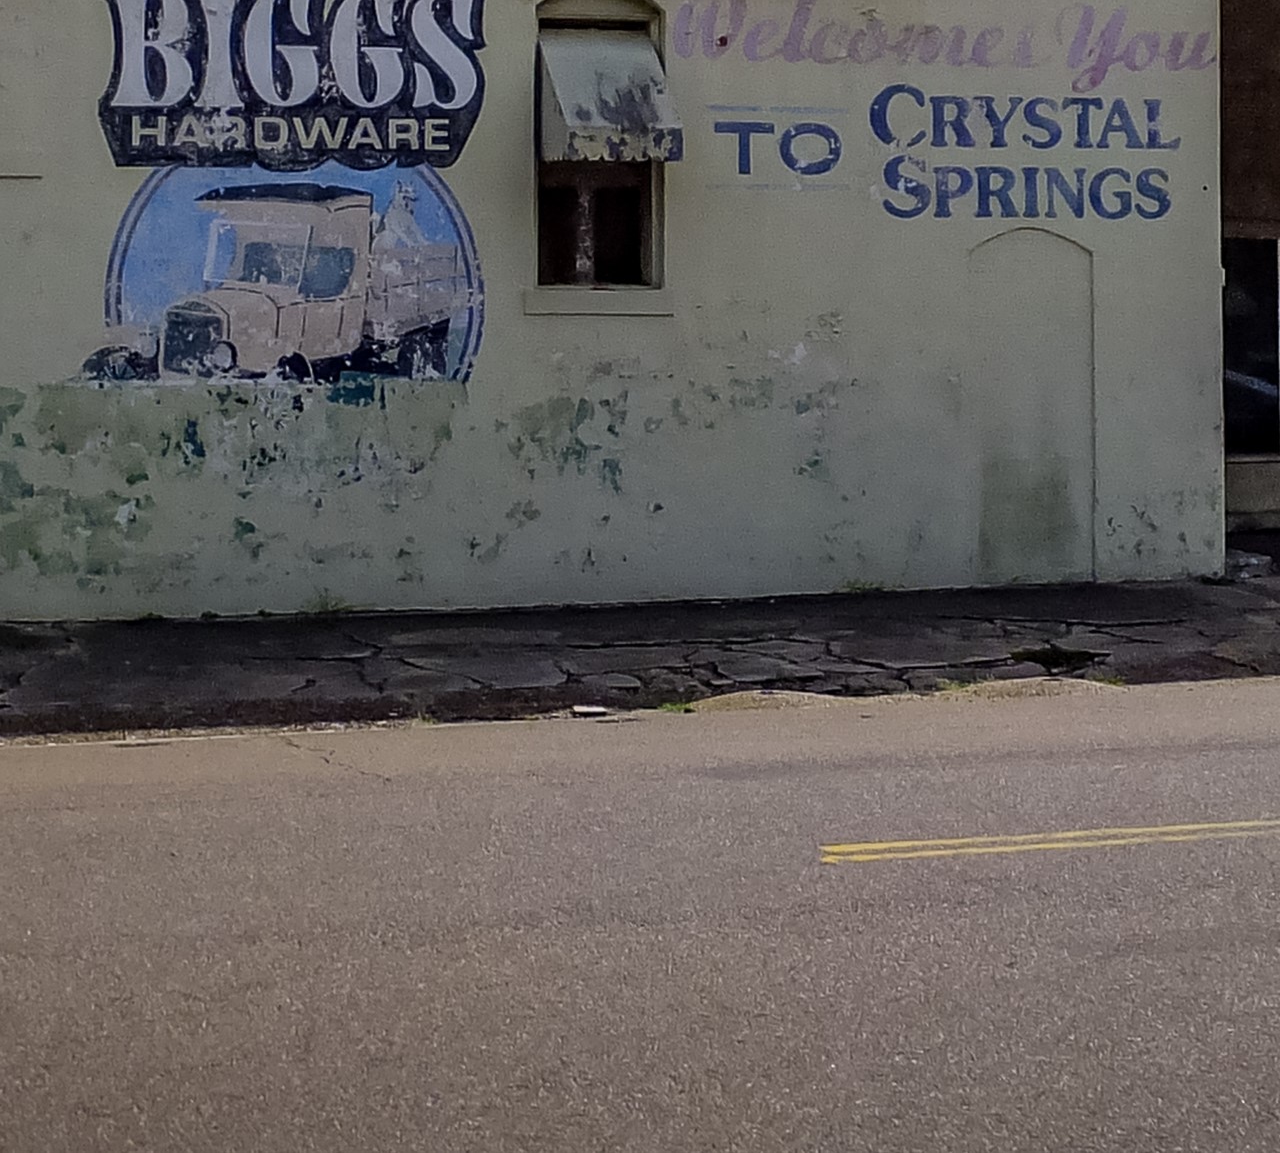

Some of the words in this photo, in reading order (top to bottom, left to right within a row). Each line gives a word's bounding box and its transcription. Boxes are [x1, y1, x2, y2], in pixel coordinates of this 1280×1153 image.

[1055, 3, 1217, 94] You
[130, 113, 452, 153] HARDWARE
[713, 120, 842, 176] TO
[868, 82, 1181, 151] CRYSTAL
[881, 153, 1172, 219] SPRINGS
